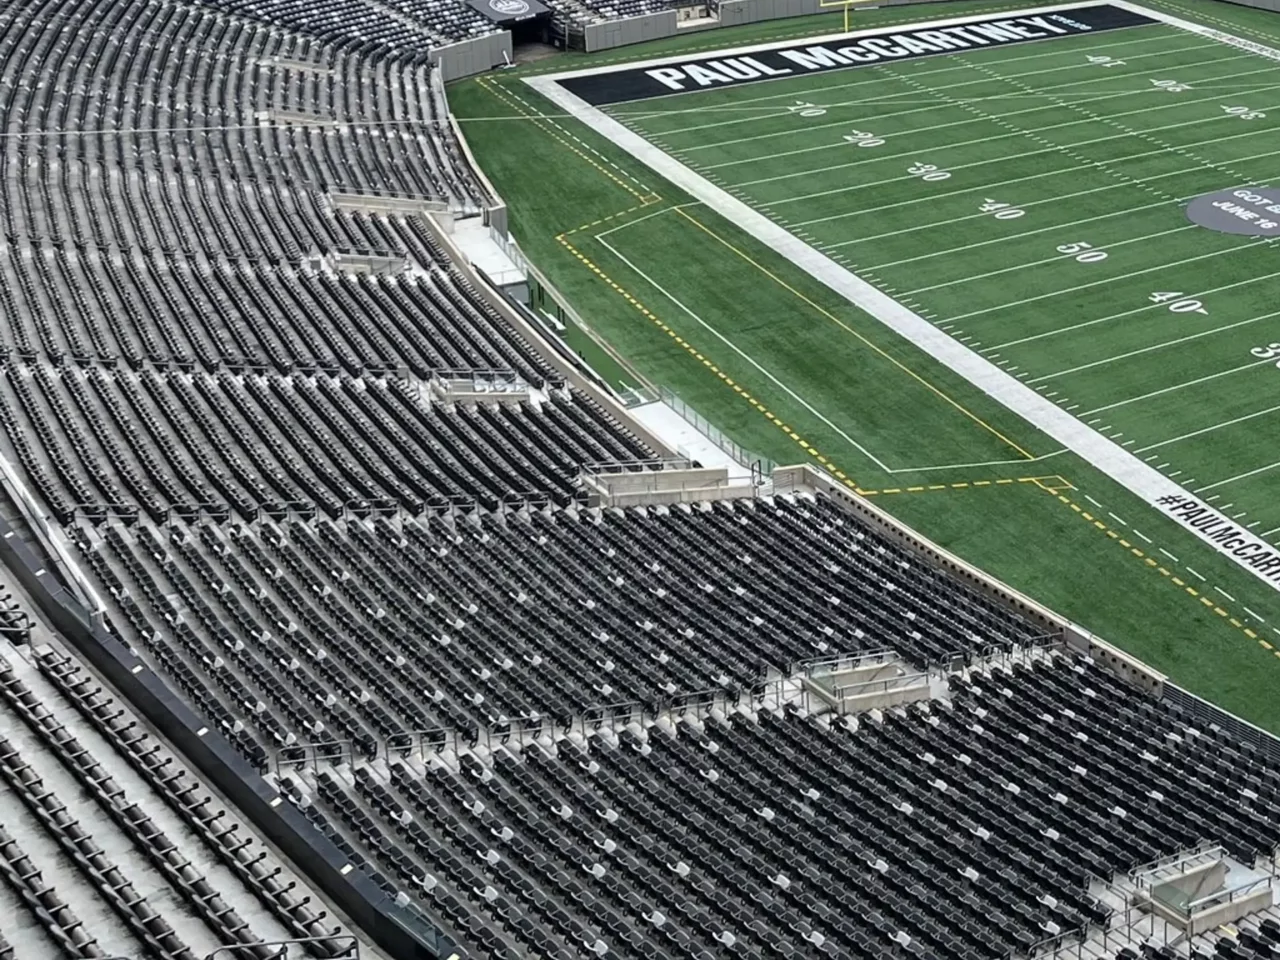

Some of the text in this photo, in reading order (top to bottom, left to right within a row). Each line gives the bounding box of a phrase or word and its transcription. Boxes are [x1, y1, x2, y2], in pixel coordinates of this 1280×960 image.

[645, 17, 1068, 90] PAUL McCARTNEY
[1089, 55, 1126, 68] 10
[787, 103, 826, 117] 10
[1225, 105, 1266, 120] 30
[843, 131, 885, 147] 20
[907, 163, 951, 181] 30
[1233, 190, 1274, 206] GOT
[979, 200, 1025, 220] 40
[1212, 201, 1278, 229] JUNE 16
[1056, 241, 1108, 262] 50
[1148, 291, 1203, 313] 40
